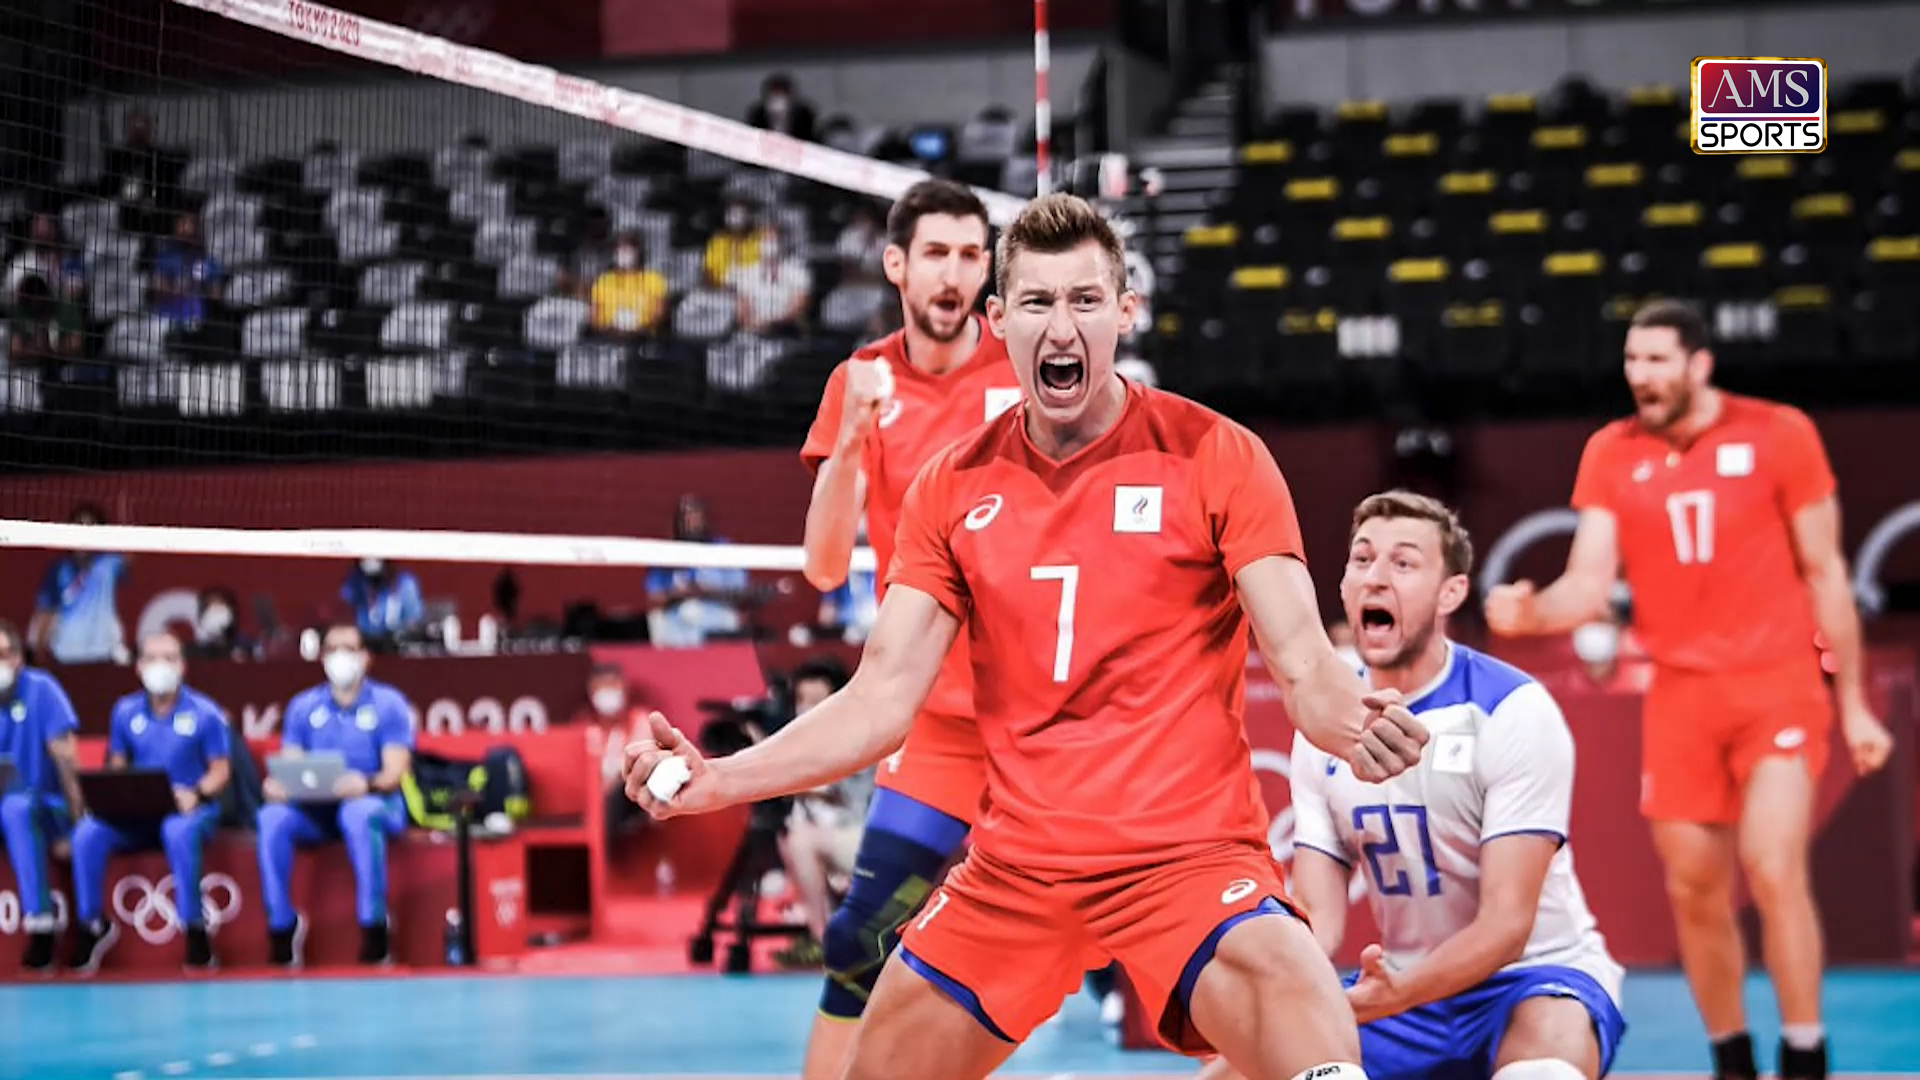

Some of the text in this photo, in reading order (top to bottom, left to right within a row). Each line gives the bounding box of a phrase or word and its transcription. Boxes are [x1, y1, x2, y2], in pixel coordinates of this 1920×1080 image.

[1666, 489, 1715, 565] 17
[1030, 565, 1078, 682] 7
[1352, 804, 1442, 897] 27
